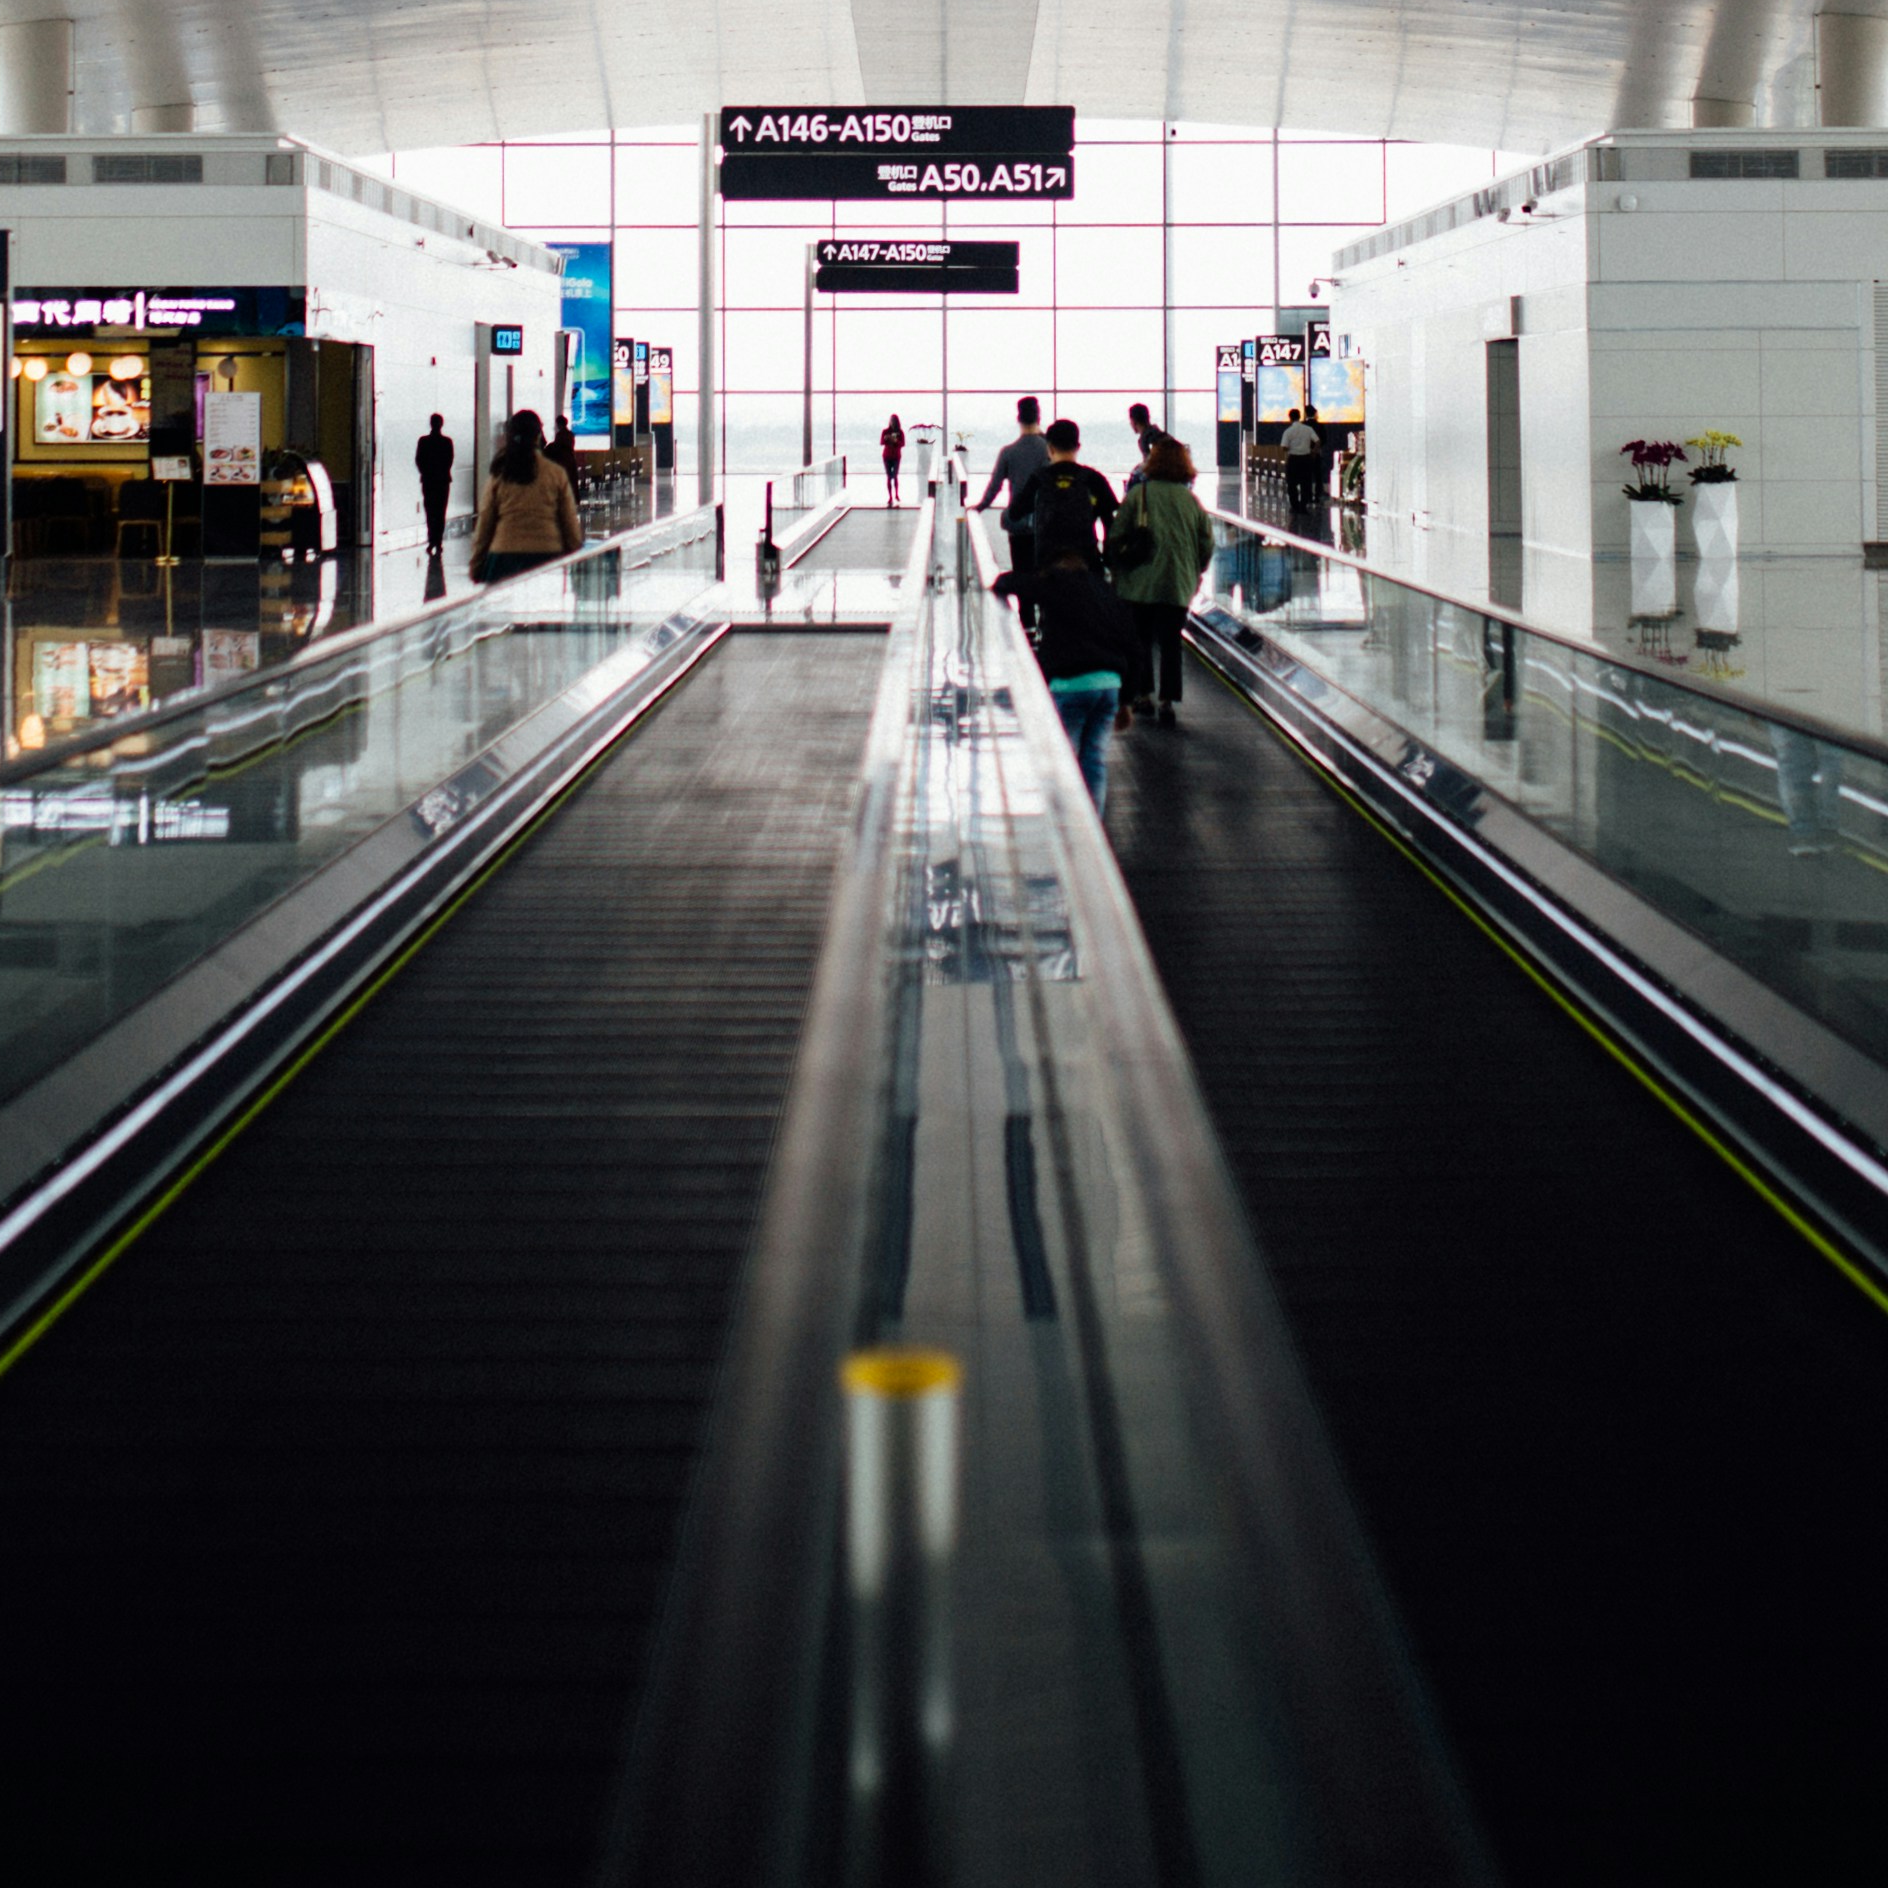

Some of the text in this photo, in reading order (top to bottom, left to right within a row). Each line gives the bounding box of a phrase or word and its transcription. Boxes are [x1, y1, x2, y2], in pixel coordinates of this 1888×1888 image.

[756, 114, 911, 142] A146-A150
[912, 116, 951, 130] 登机口
[911, 132, 940, 142] Gates
[878, 165, 917, 180] 登机口
[888, 181, 917, 192] Gates
[838, 243, 926, 261] A147-A150
[1261, 344, 1302, 360] A147
